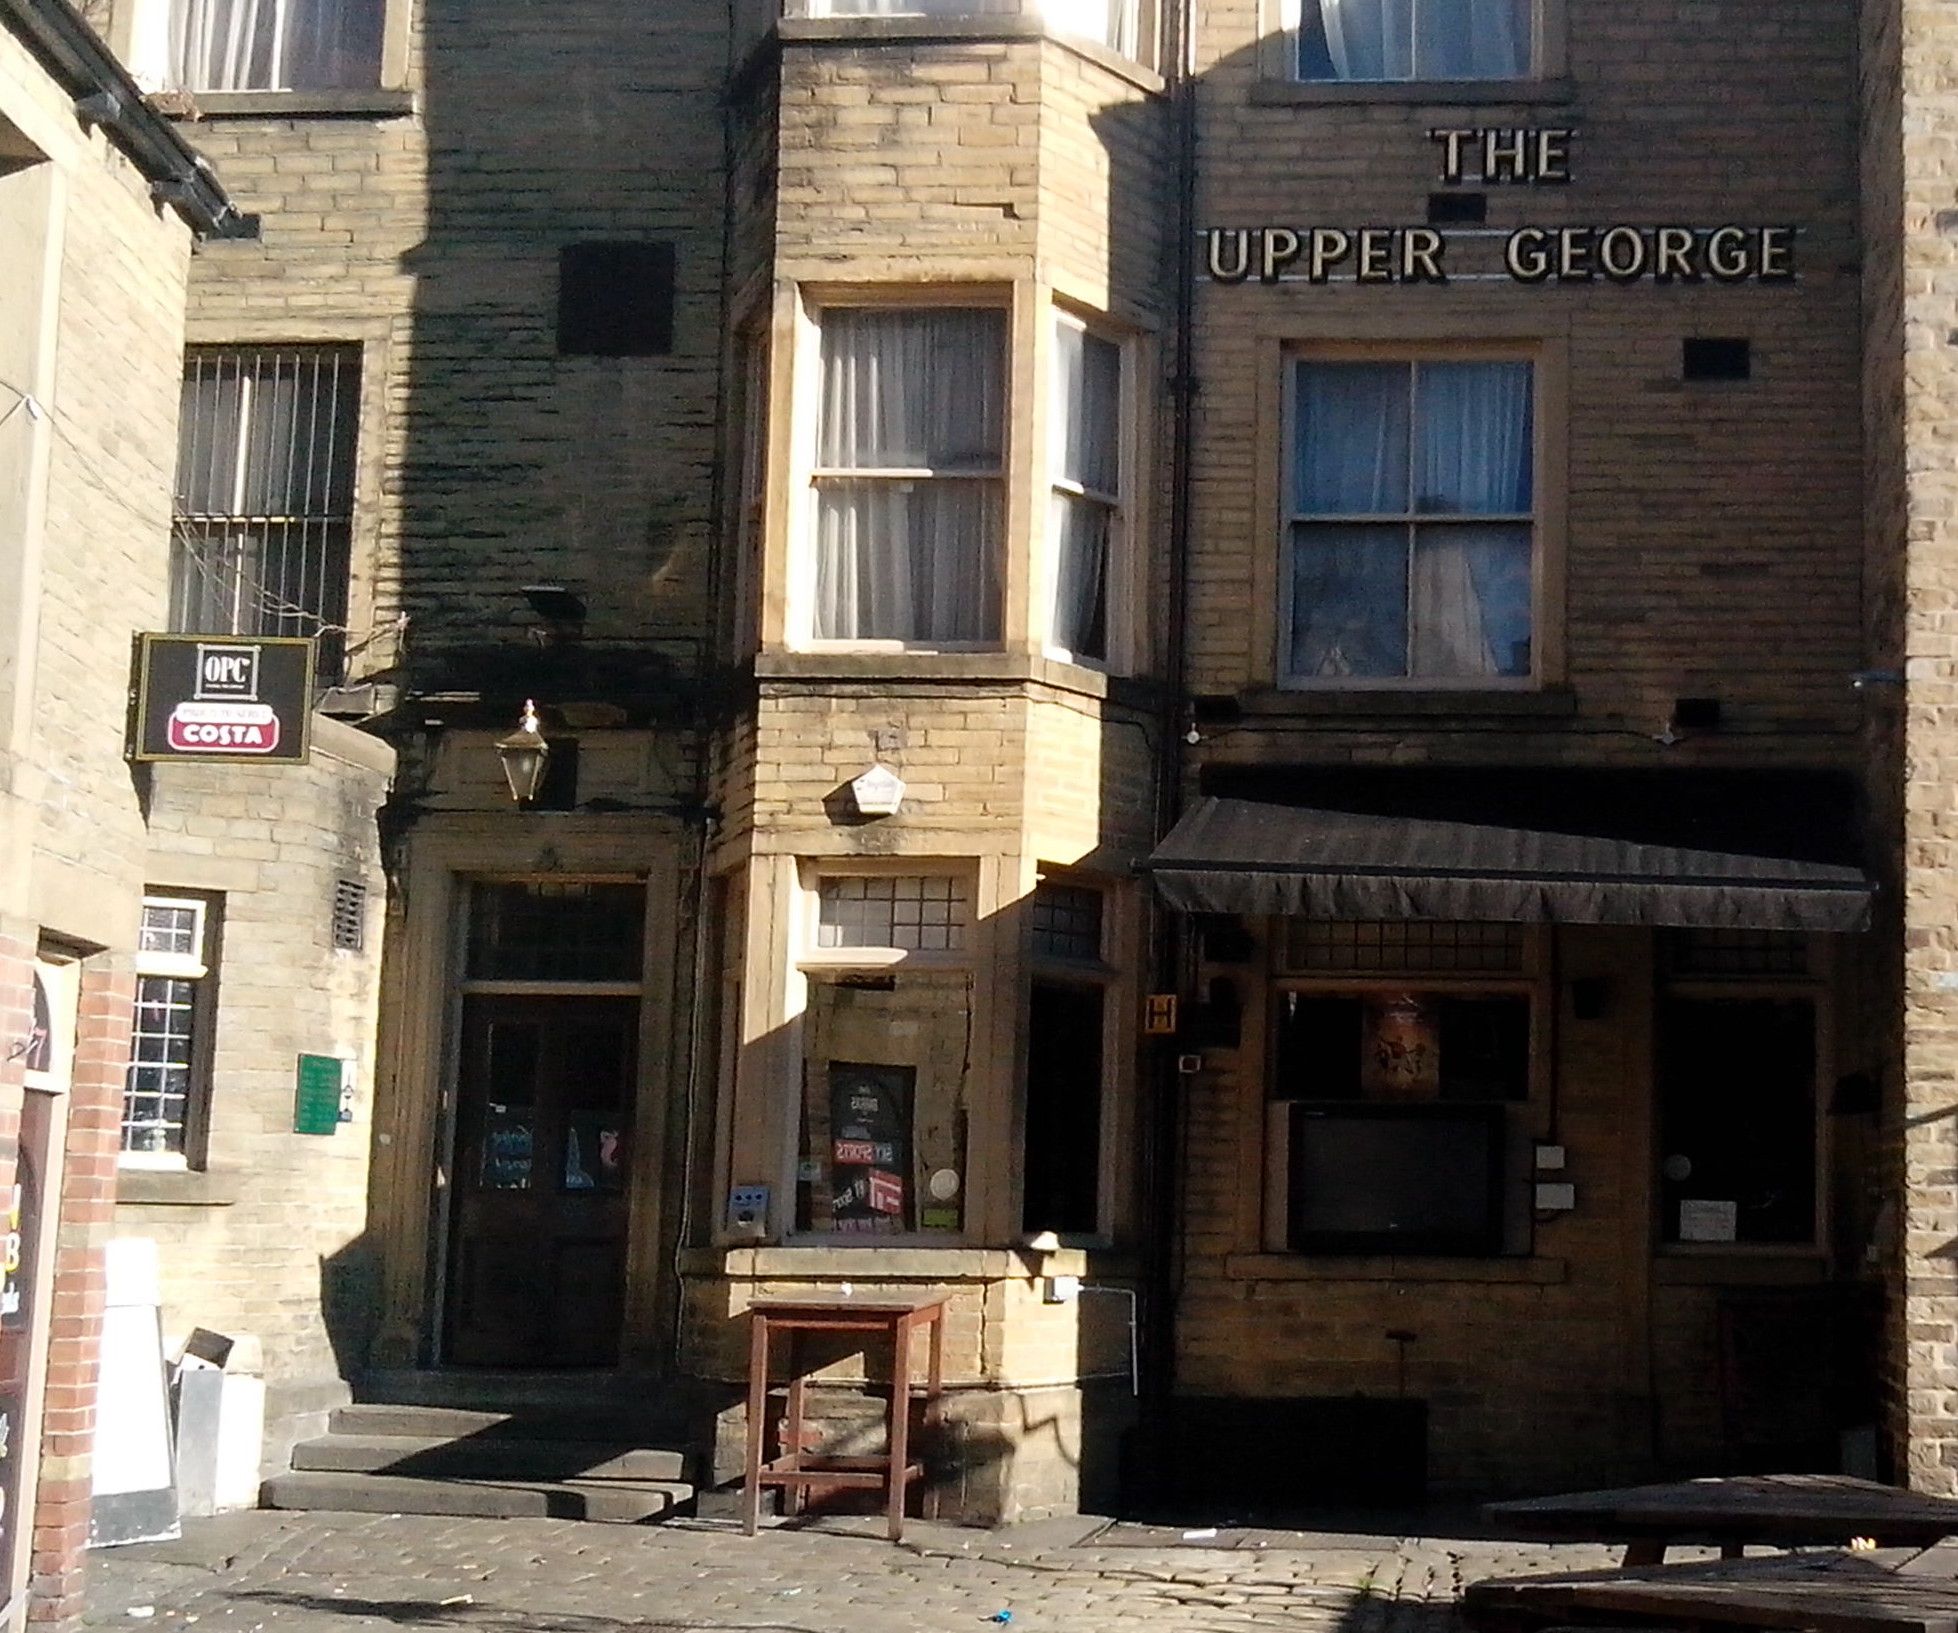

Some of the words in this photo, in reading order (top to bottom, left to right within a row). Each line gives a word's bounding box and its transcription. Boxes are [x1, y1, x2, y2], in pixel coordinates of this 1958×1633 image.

[1433, 129, 1570, 181] THE
[1207, 228, 1447, 281] UPPER
[1505, 227, 1791, 280] GEORGE
[205, 656, 251, 682] OPC
[183, 724, 262, 745] COSTA
[1149, 998, 1172, 1030] H
